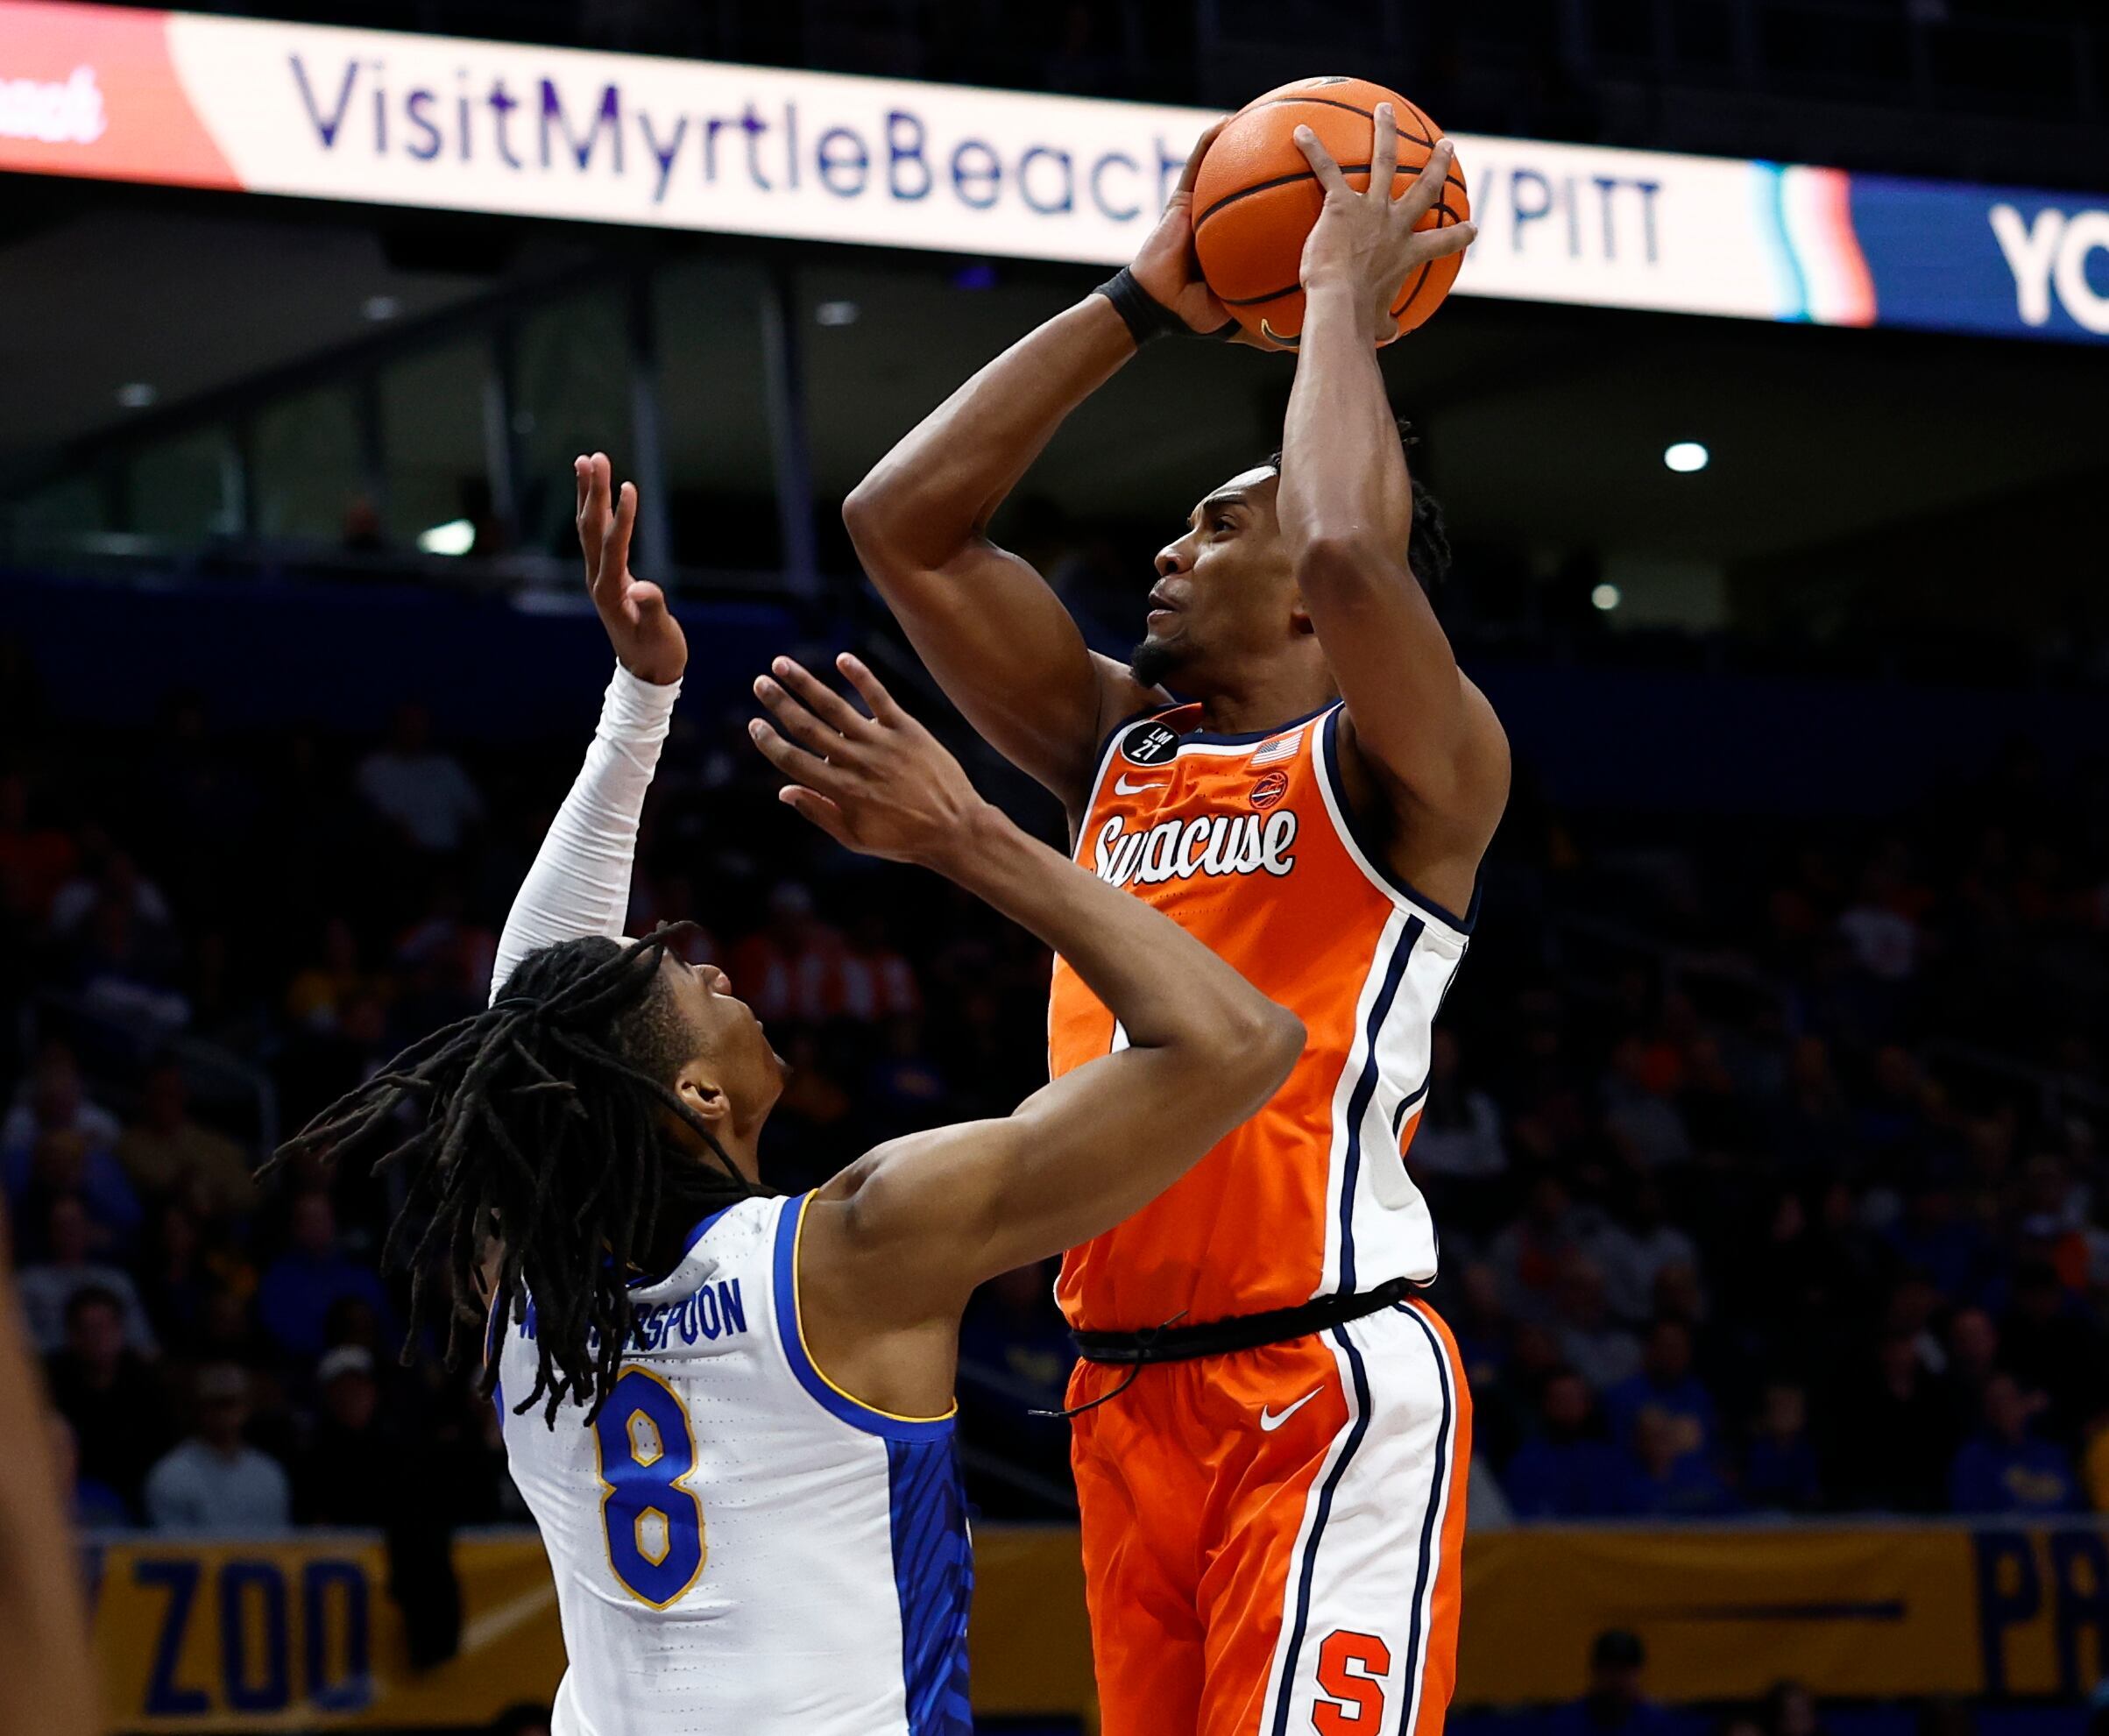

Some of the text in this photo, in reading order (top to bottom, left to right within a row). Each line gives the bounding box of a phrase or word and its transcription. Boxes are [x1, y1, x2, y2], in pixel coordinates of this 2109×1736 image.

[1130, 739, 1162, 762] 21
[1148, 726, 1175, 746] LM
[520, 1277, 748, 1351] RSPOON
[593, 1363, 707, 1612] 8
[133, 1558, 375, 1716] ZOO
[1311, 1629, 1391, 1736] S
